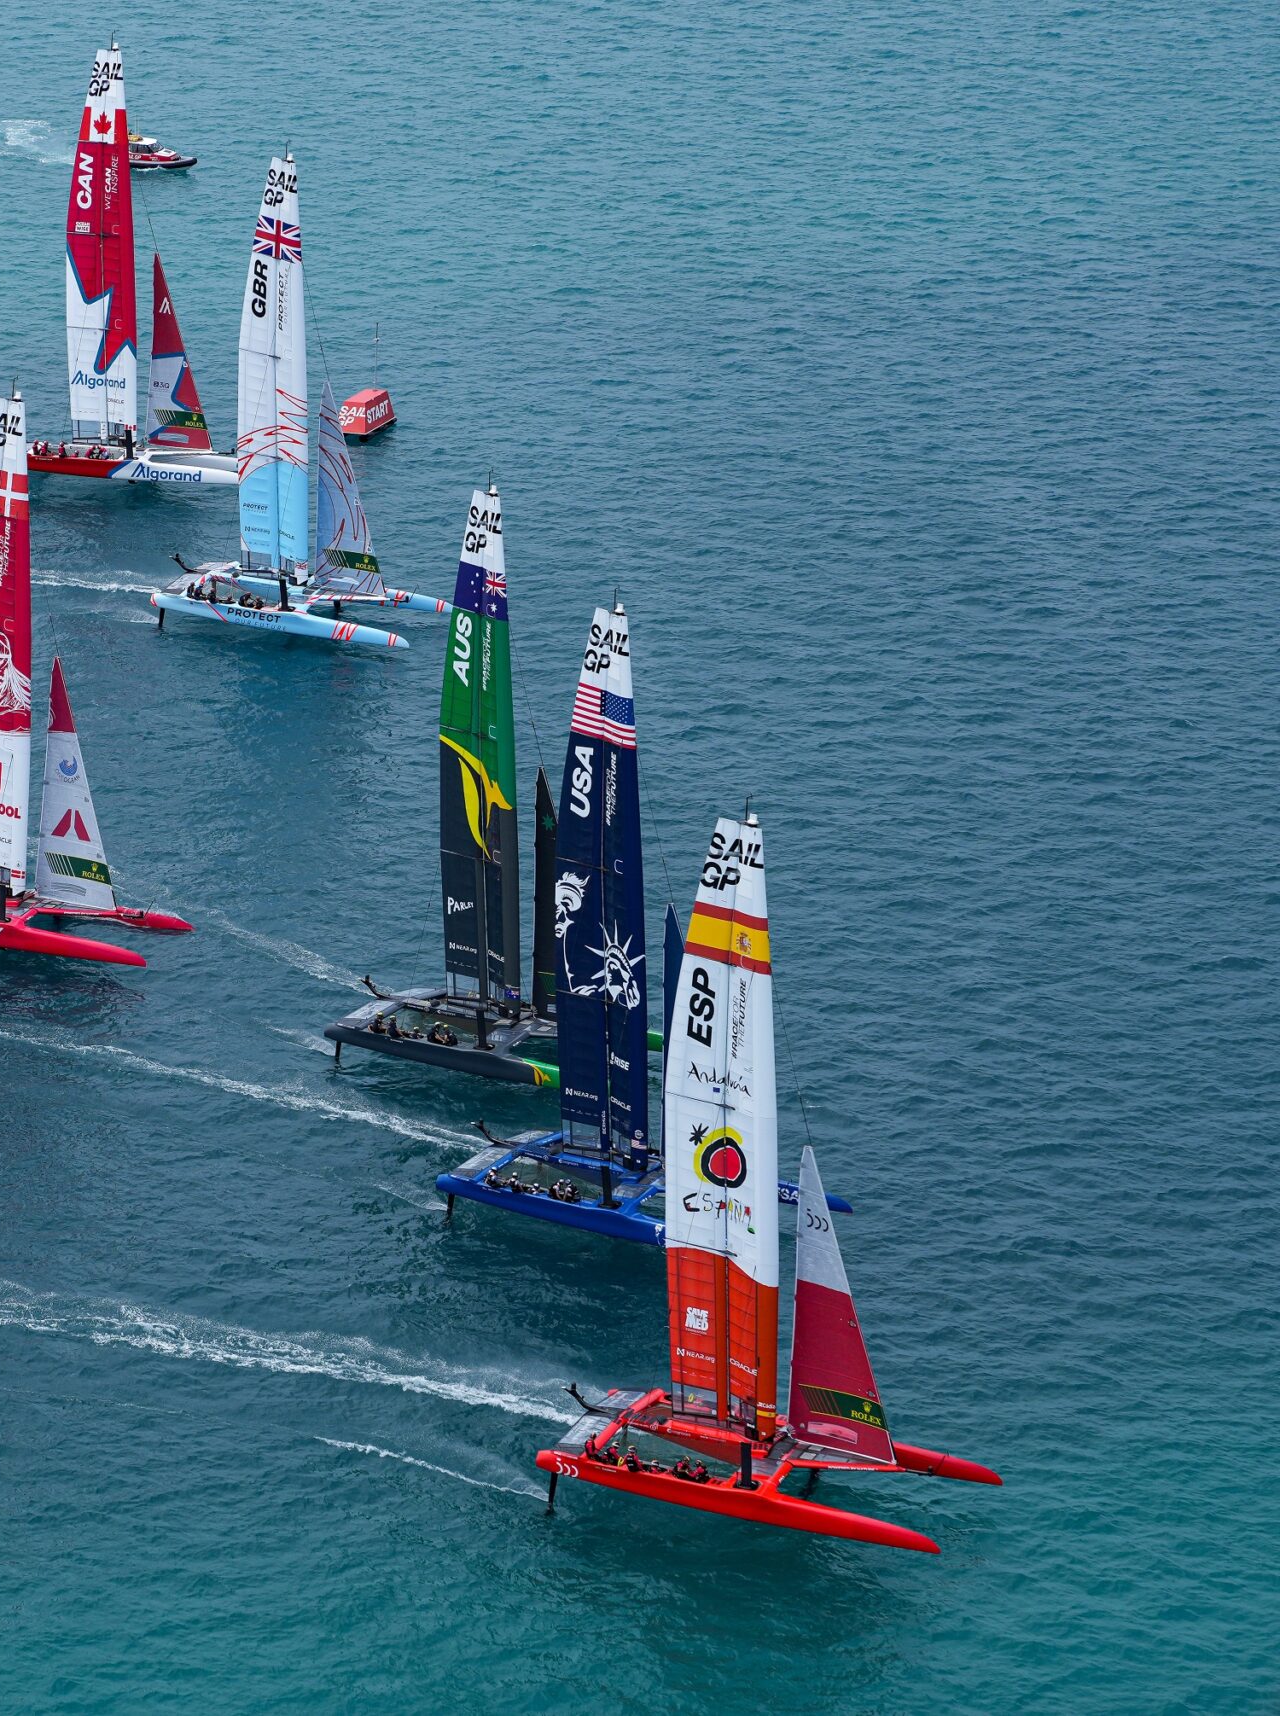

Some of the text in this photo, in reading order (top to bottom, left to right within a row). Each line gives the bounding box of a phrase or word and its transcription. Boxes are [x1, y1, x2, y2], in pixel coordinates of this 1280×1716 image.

[91, 61, 124, 81] SAIL
[88, 79, 110, 97] GP
[76, 152, 94, 210] CAN
[111, 155, 119, 194] INSPIRE
[267, 168, 298, 194] SAIL
[105, 194, 112, 210] WE
[264, 188, 284, 207] GP
[251, 259, 268, 318] GBR
[71, 371, 126, 389] Algorand
[339, 405, 366, 417] SAIL
[366, 400, 389, 423] START
[185, 420, 203, 428] ROLEX
[338, 416, 354, 427] GP
[131, 462, 202, 482] Algorand
[469, 506, 502, 535] SAIL
[465, 531, 487, 554] GP
[355, 562, 376, 572] ROLEX
[227, 607, 281, 623] PROTECT
[453, 612, 473, 687] AUS
[589, 623, 630, 657] SAIL
[583, 649, 611, 674] GP
[569, 745, 594, 818] USA
[707, 832, 764, 870] SAIL
[81, 870, 105, 882] ROLEX
[700, 861, 741, 891] GP
[447, 896, 474, 915] PARLEY
[487, 949, 505, 963] ORACLE
[687, 967, 716, 1048] ESP
[738, 978, 747, 1048] THEFUTURE
[731, 995, 739, 1059] #RACEFOR
[614, 1055, 630, 1071] RISE
[573, 1090, 598, 1101] NEAR.org
[610, 1096, 632, 1112] ORACLE
[778, 1187, 799, 1202] SA
[686, 1306, 709, 1319] SAVE
[685, 1316, 709, 1331] MED
[686, 1350, 716, 1364] NEAR.org
[729, 1358, 758, 1376] ORACLE
[851, 1410, 882, 1426] ROLEX
